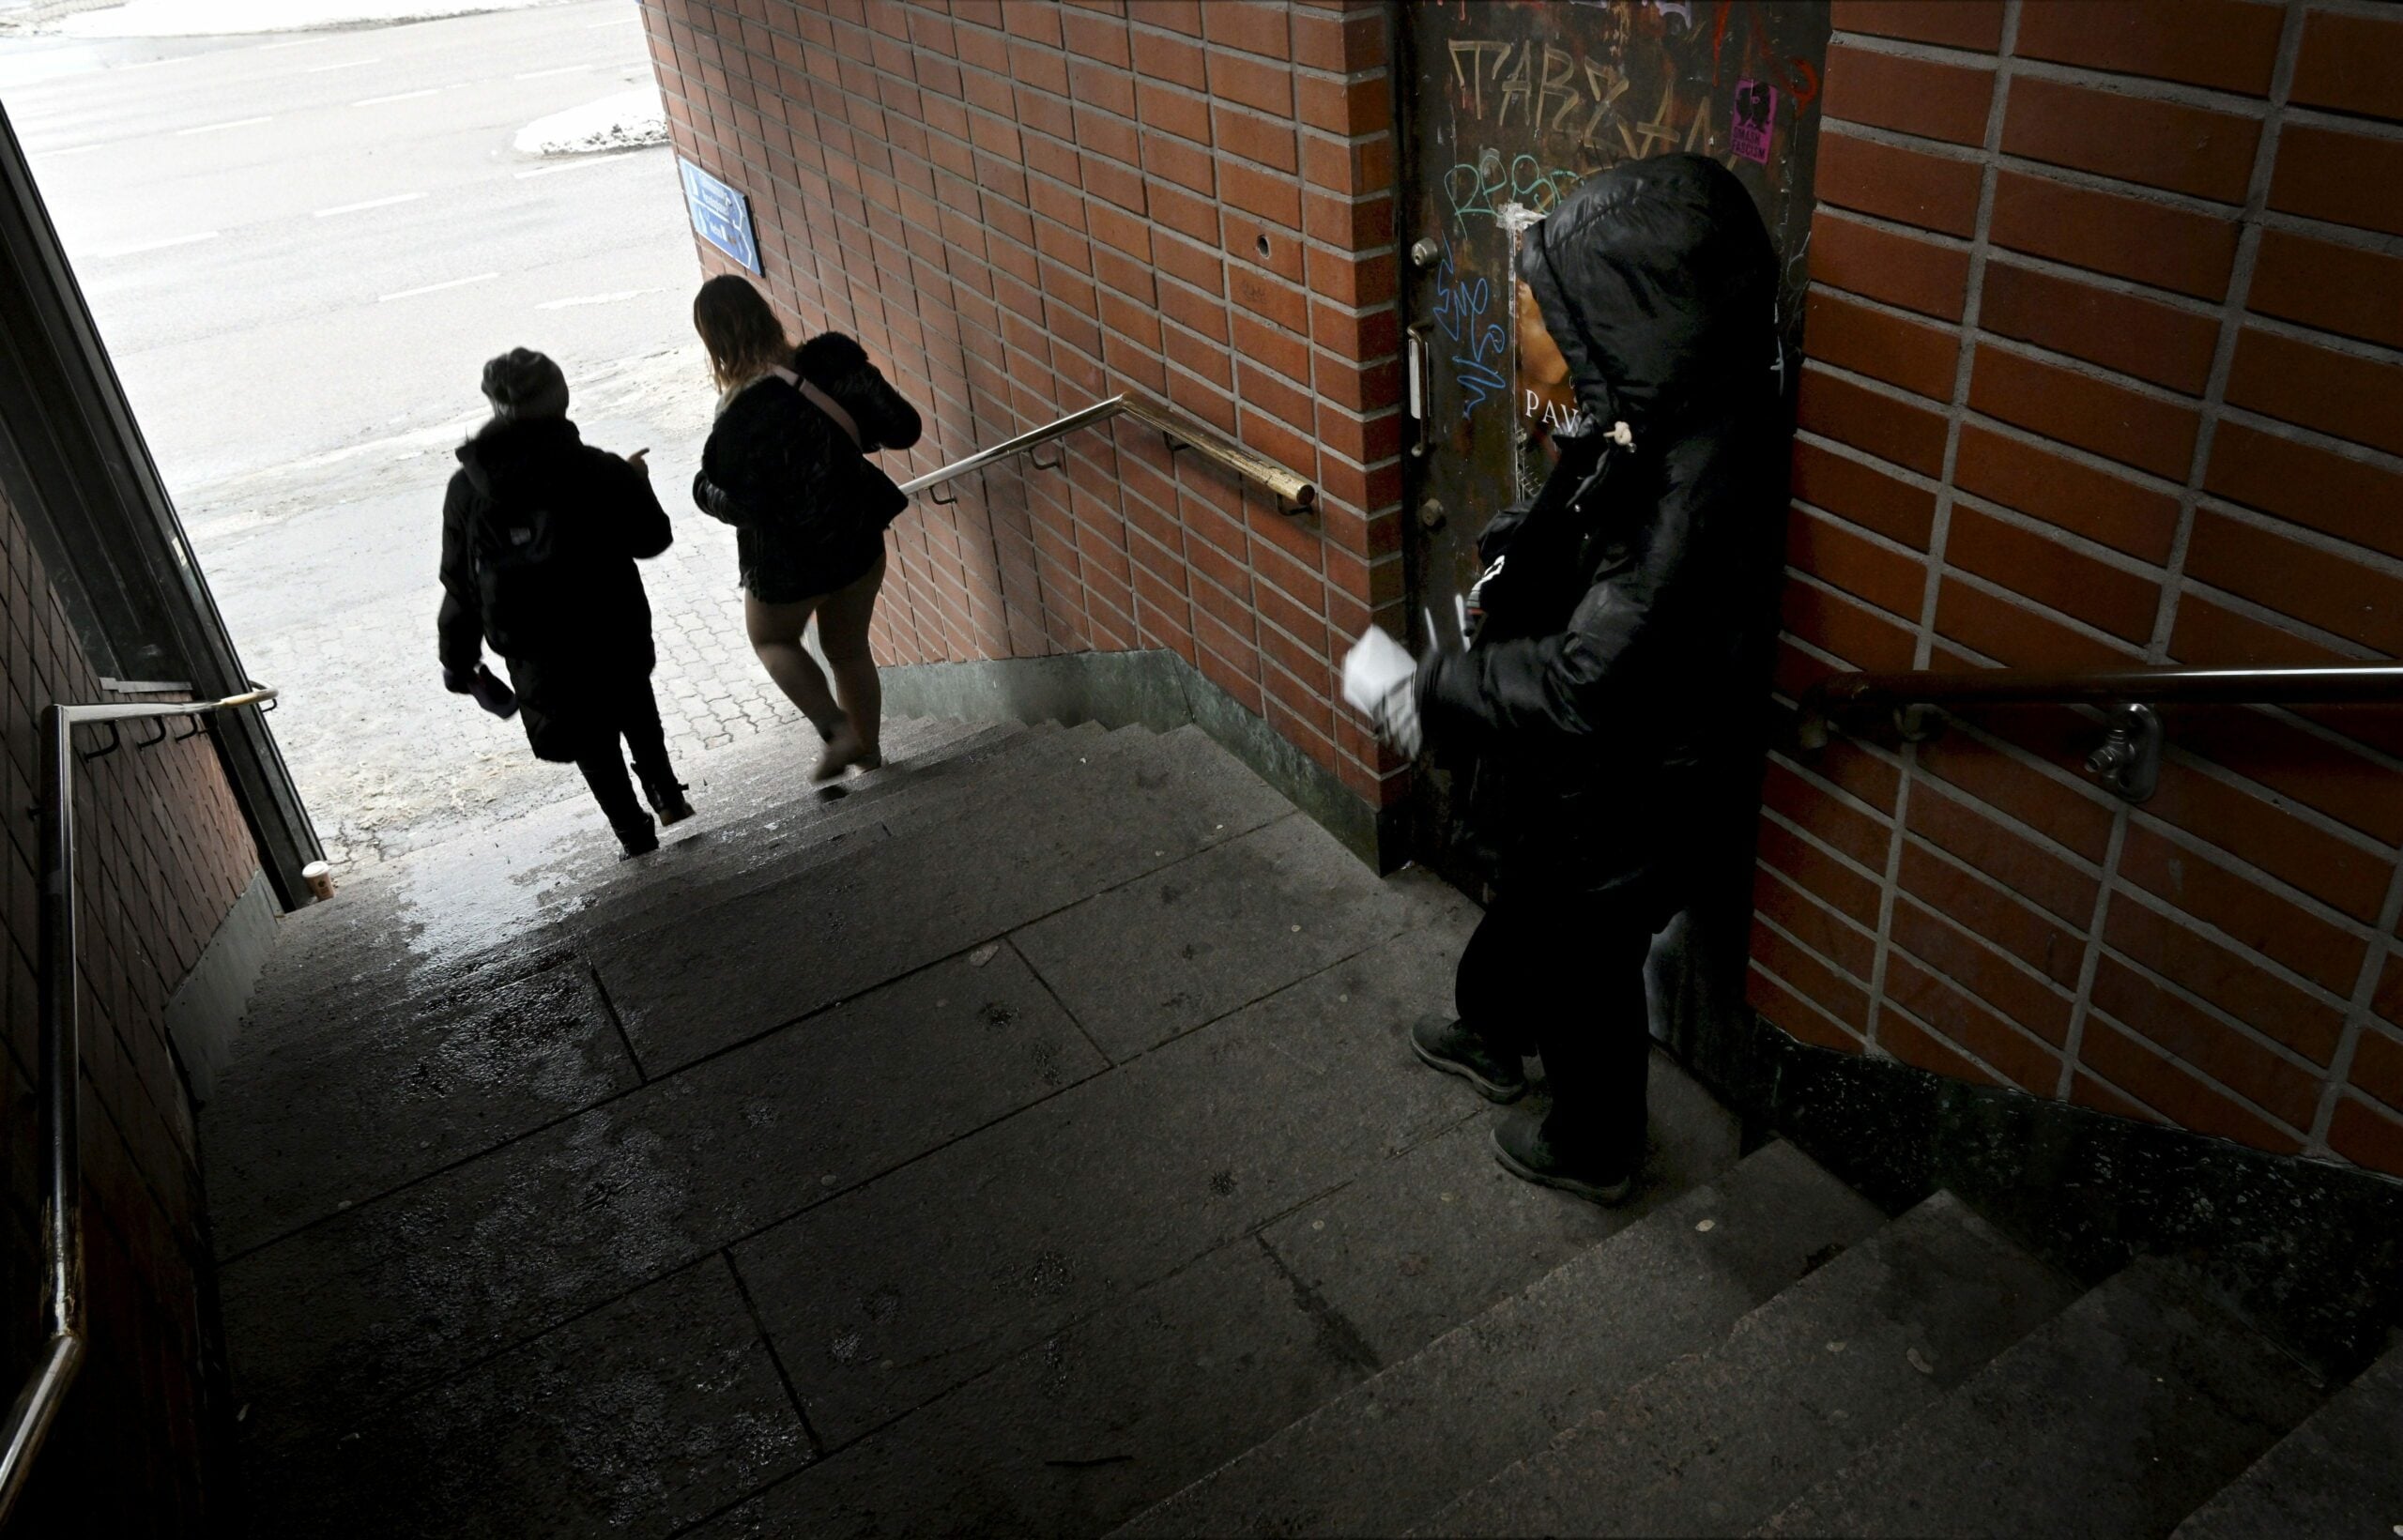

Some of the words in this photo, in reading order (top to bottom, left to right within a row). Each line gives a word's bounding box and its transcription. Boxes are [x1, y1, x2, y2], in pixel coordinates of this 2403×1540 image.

[1734, 126, 1761, 146] SMASH
[1732, 138, 1765, 160] FASCISM
[1525, 389, 1579, 432] PAV
